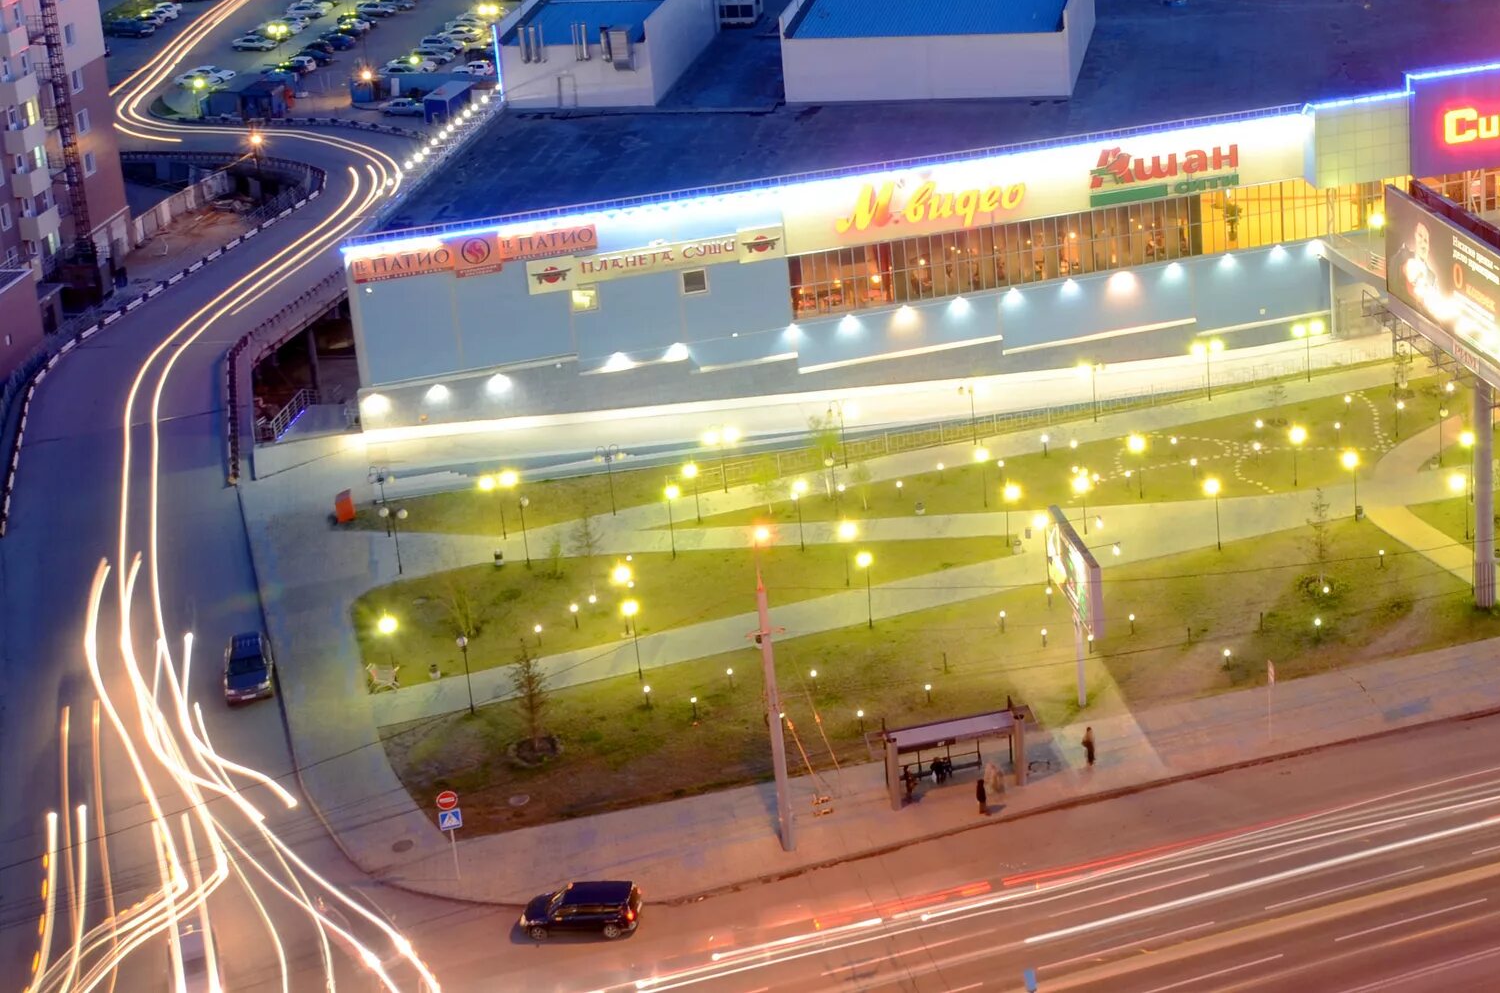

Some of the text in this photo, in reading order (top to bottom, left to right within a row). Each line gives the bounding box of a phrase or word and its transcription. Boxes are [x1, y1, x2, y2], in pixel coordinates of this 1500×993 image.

[1089, 144, 1239, 189] Ашан
[519, 228, 593, 251] ПАТИО
[372, 249, 449, 273] ПАТИО
[581, 250, 675, 274] ПЛАНЕТА
[682, 238, 735, 259] СУШИ
